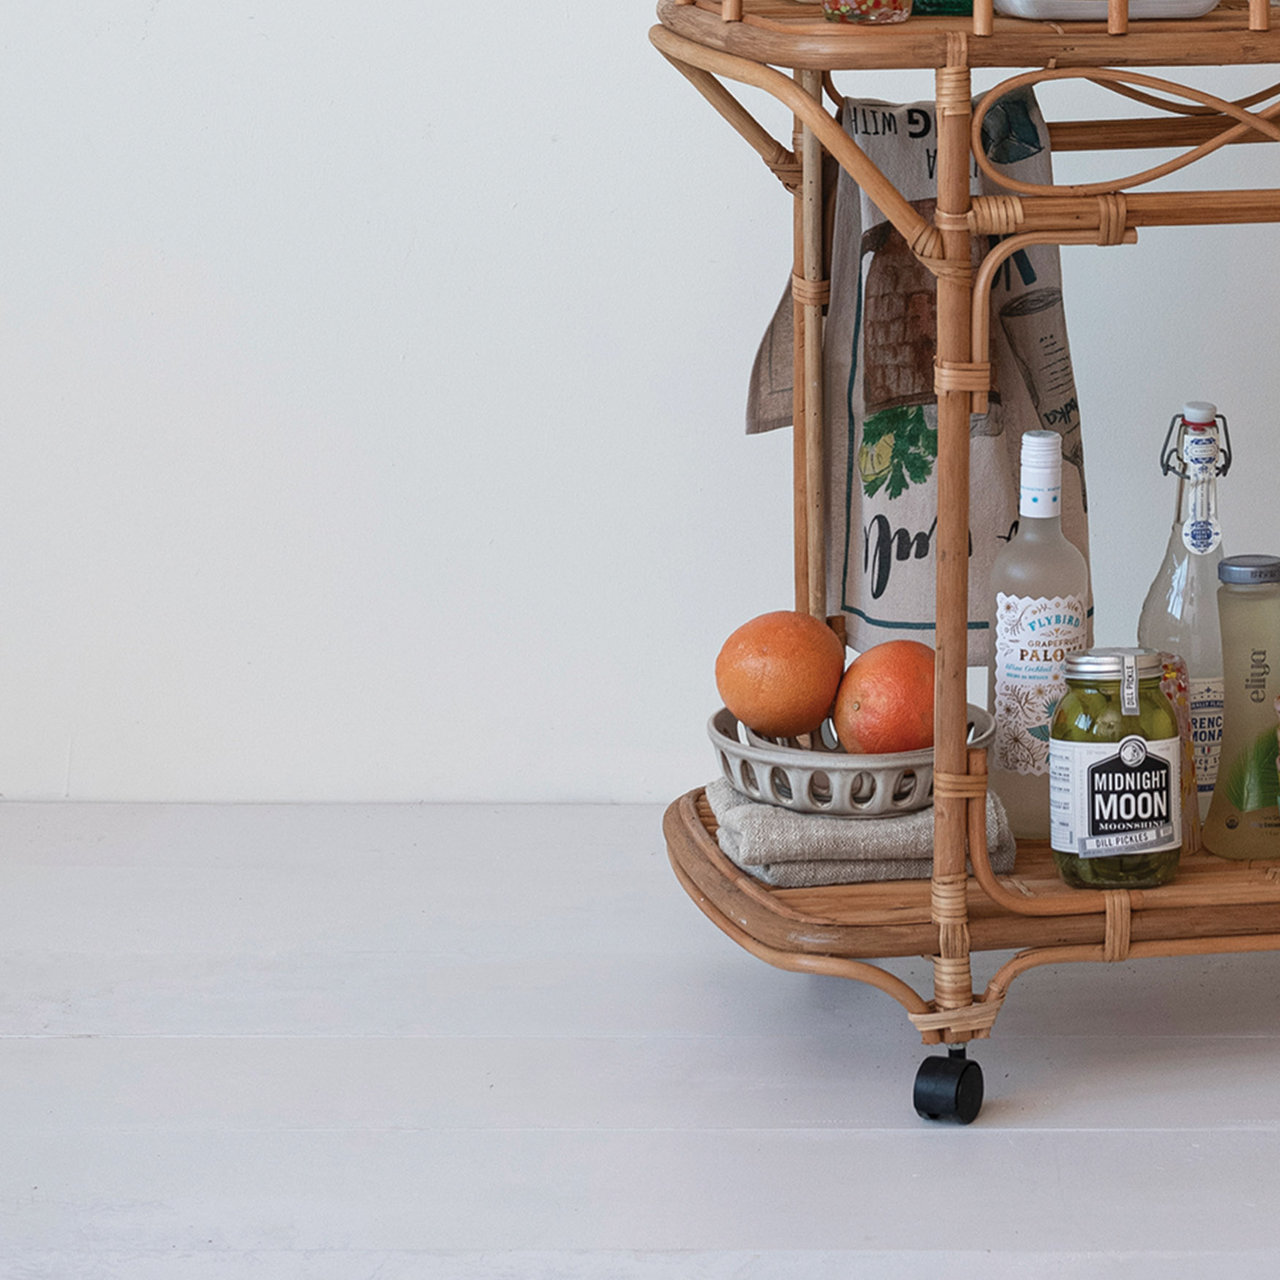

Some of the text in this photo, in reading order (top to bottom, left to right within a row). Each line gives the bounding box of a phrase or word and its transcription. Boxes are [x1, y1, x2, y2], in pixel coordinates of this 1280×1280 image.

[1027, 614, 1080, 632] FLYBIRD
[1027, 635, 1079, 648] GRAPEFRUIT
[1019, 644, 1083, 663] PALO
[1245, 648, 1271, 704] eliya
[1126, 665, 1135, 706] DILL PICKLE
[1191, 715, 1223, 730] RENC
[1193, 729, 1223, 742] MONA
[1094, 770, 1167, 791] MIDNIGHT
[1094, 790, 1167, 821] MOON
[1096, 832, 1149, 849] DILL PICKLES
